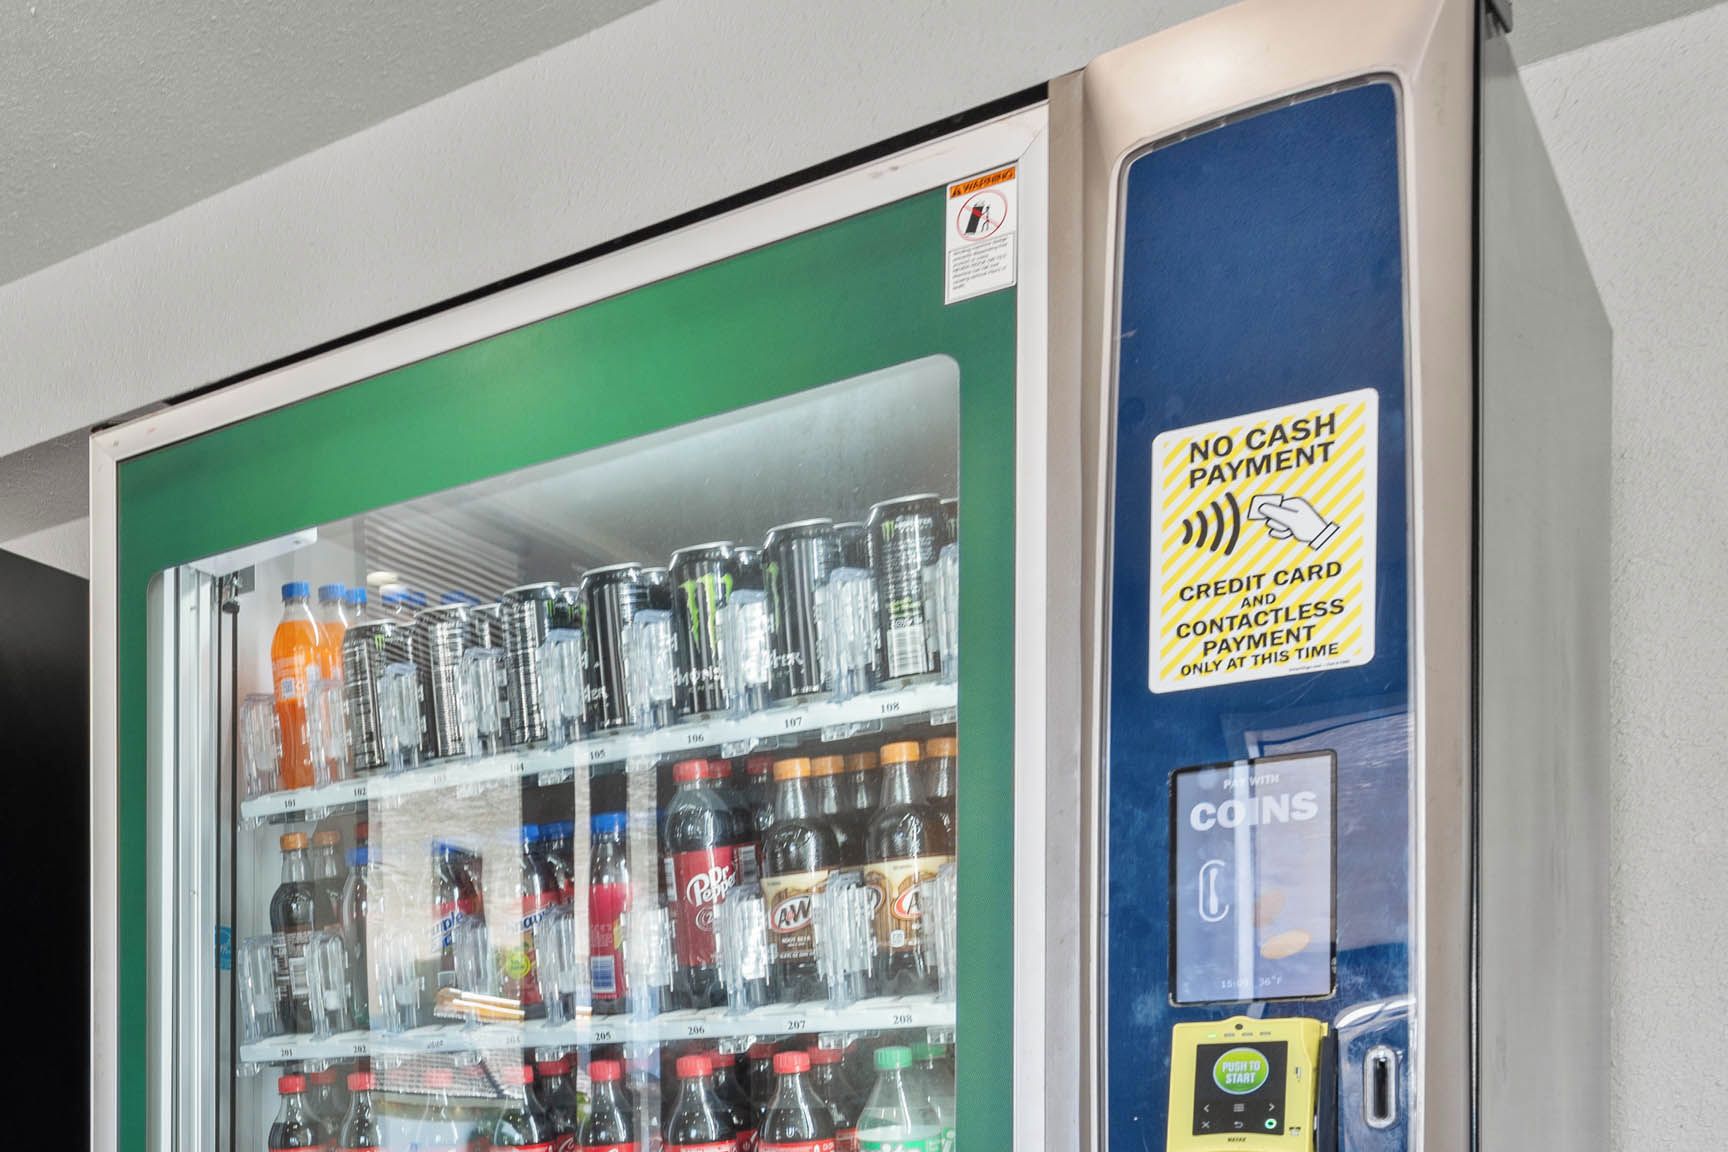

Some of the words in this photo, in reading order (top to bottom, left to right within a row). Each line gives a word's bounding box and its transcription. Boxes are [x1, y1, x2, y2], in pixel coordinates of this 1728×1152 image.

[1190, 434, 1233, 464] NO
[1246, 412, 1336, 450] CASH
[1189, 441, 1336, 489] PAYMENT
[1179, 573, 1267, 602] CREDIT
[1273, 561, 1342, 586] CARD
[1241, 593, 1276, 609] AND
[1176, 599, 1345, 639] CONTACTLESS
[1203, 625, 1316, 657] PAYMENT
[1180, 659, 1222, 677] ONLY
[1226, 656, 1248, 670] AT
[1251, 650, 1290, 666] THIS
[1295, 642, 1339, 660] TIME
[880, 702, 899, 713] 108
[784, 717, 802, 728] 107
[687, 733, 704, 744] 106
[590, 750, 606, 761] 105
[1249, 774, 1280, 787] WITH
[1190, 790, 1319, 832] COINS
[708, 866, 729, 882] Dr
[787, 1020, 806, 1030] 207
[894, 1015, 912, 1025] 208
[595, 1031, 611, 1041] 205
[688, 1025, 705, 1035] 206
[1222, 1061, 1248, 1073] PUSH
[1249, 1061, 1261, 1072] TO
[1225, 1072, 1256, 1084] START
